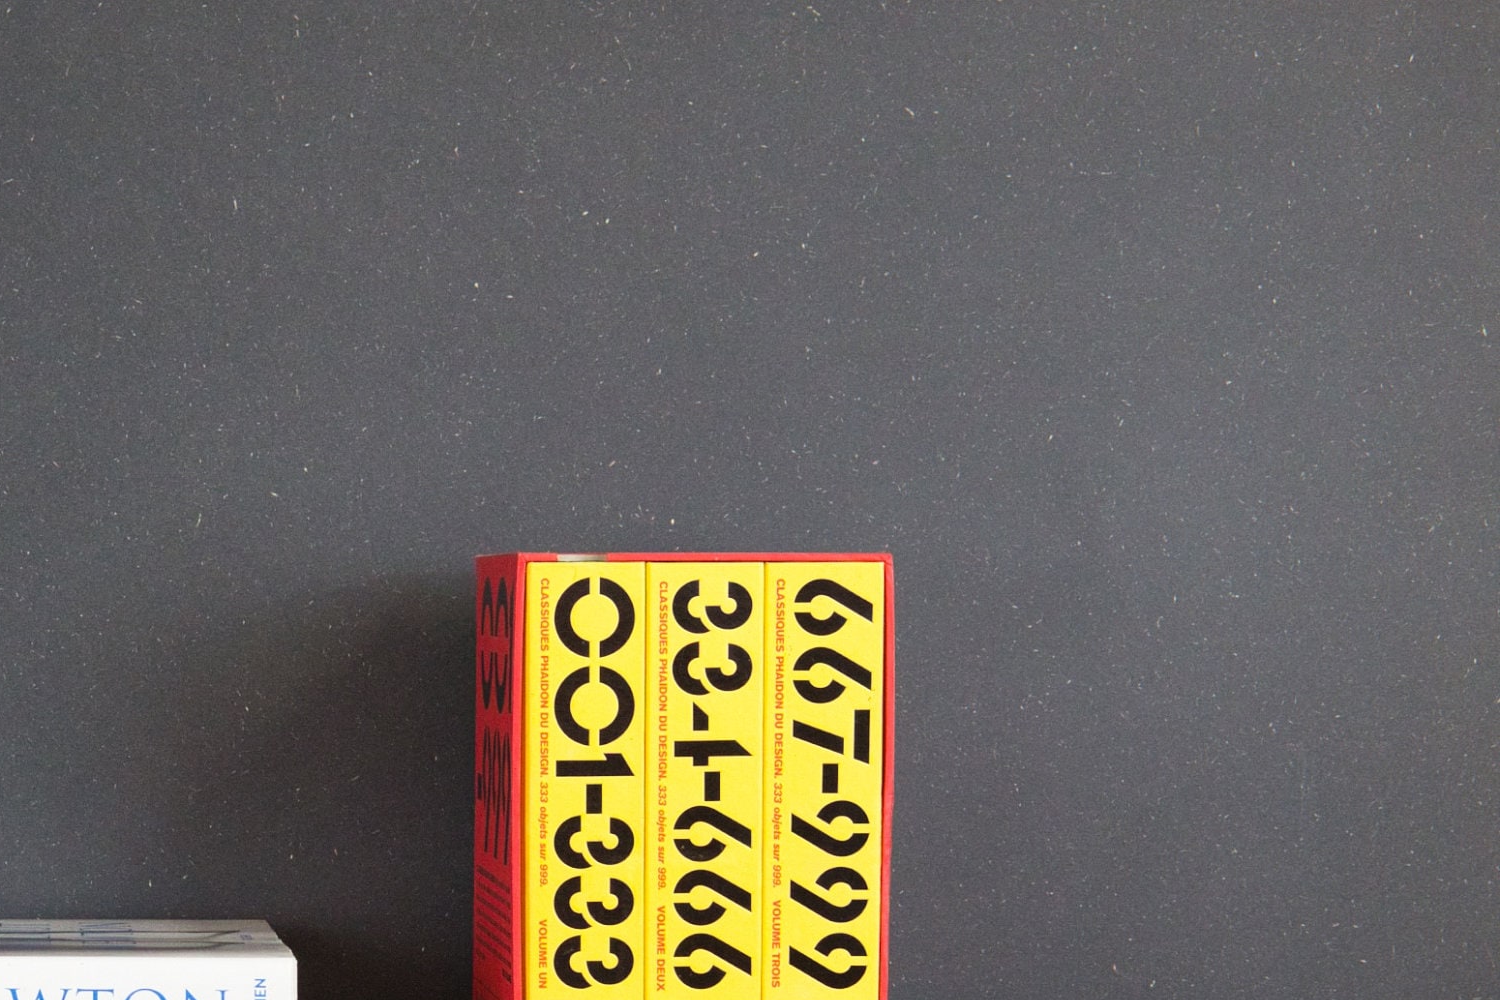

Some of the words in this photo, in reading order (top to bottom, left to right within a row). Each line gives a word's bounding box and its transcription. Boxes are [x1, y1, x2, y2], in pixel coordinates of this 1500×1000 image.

[540, 577, 550, 652] CLASSIQUES
[659, 581, 669, 656] CLASSIQUES
[776, 578, 785, 654] CLASSIQUES
[539, 655, 549, 710] PHAIDON
[659, 658, 668, 713] PHAIDON
[774, 655, 784, 710] PHAIDON
[539, 712, 549, 728] DU
[658, 715, 668, 732] DU
[774, 713, 784, 730] DU
[539, 731, 549, 778] DESIGN.
[658, 735, 667, 781] DESIGN.
[774, 732, 784, 779] DESIGN.
[539, 783, 549, 804] 333
[553, 577, 635, 989] 001-333
[658, 787, 667, 807] 333
[672, 580, 753, 990] 334-666
[773, 783, 783, 804] 333
[789, 578, 873, 990] 667-999
[538, 806, 549, 840] objets
[656, 810, 667, 844] objets
[771, 807, 783, 841] objets
[539, 843, 547, 861] sur
[657, 846, 665, 865] sur
[538, 864, 548, 888] 999.
[657, 867, 666, 891] 999.
[772, 864, 781, 888] 999.
[656, 905, 666, 954] VOLUME
[771, 900, 781, 949] VOLUME
[538, 919, 548, 968] VOLUME
[538, 972, 548, 990] UN
[656, 958, 666, 992] DEUX
[771, 953, 781, 988] TROIS
